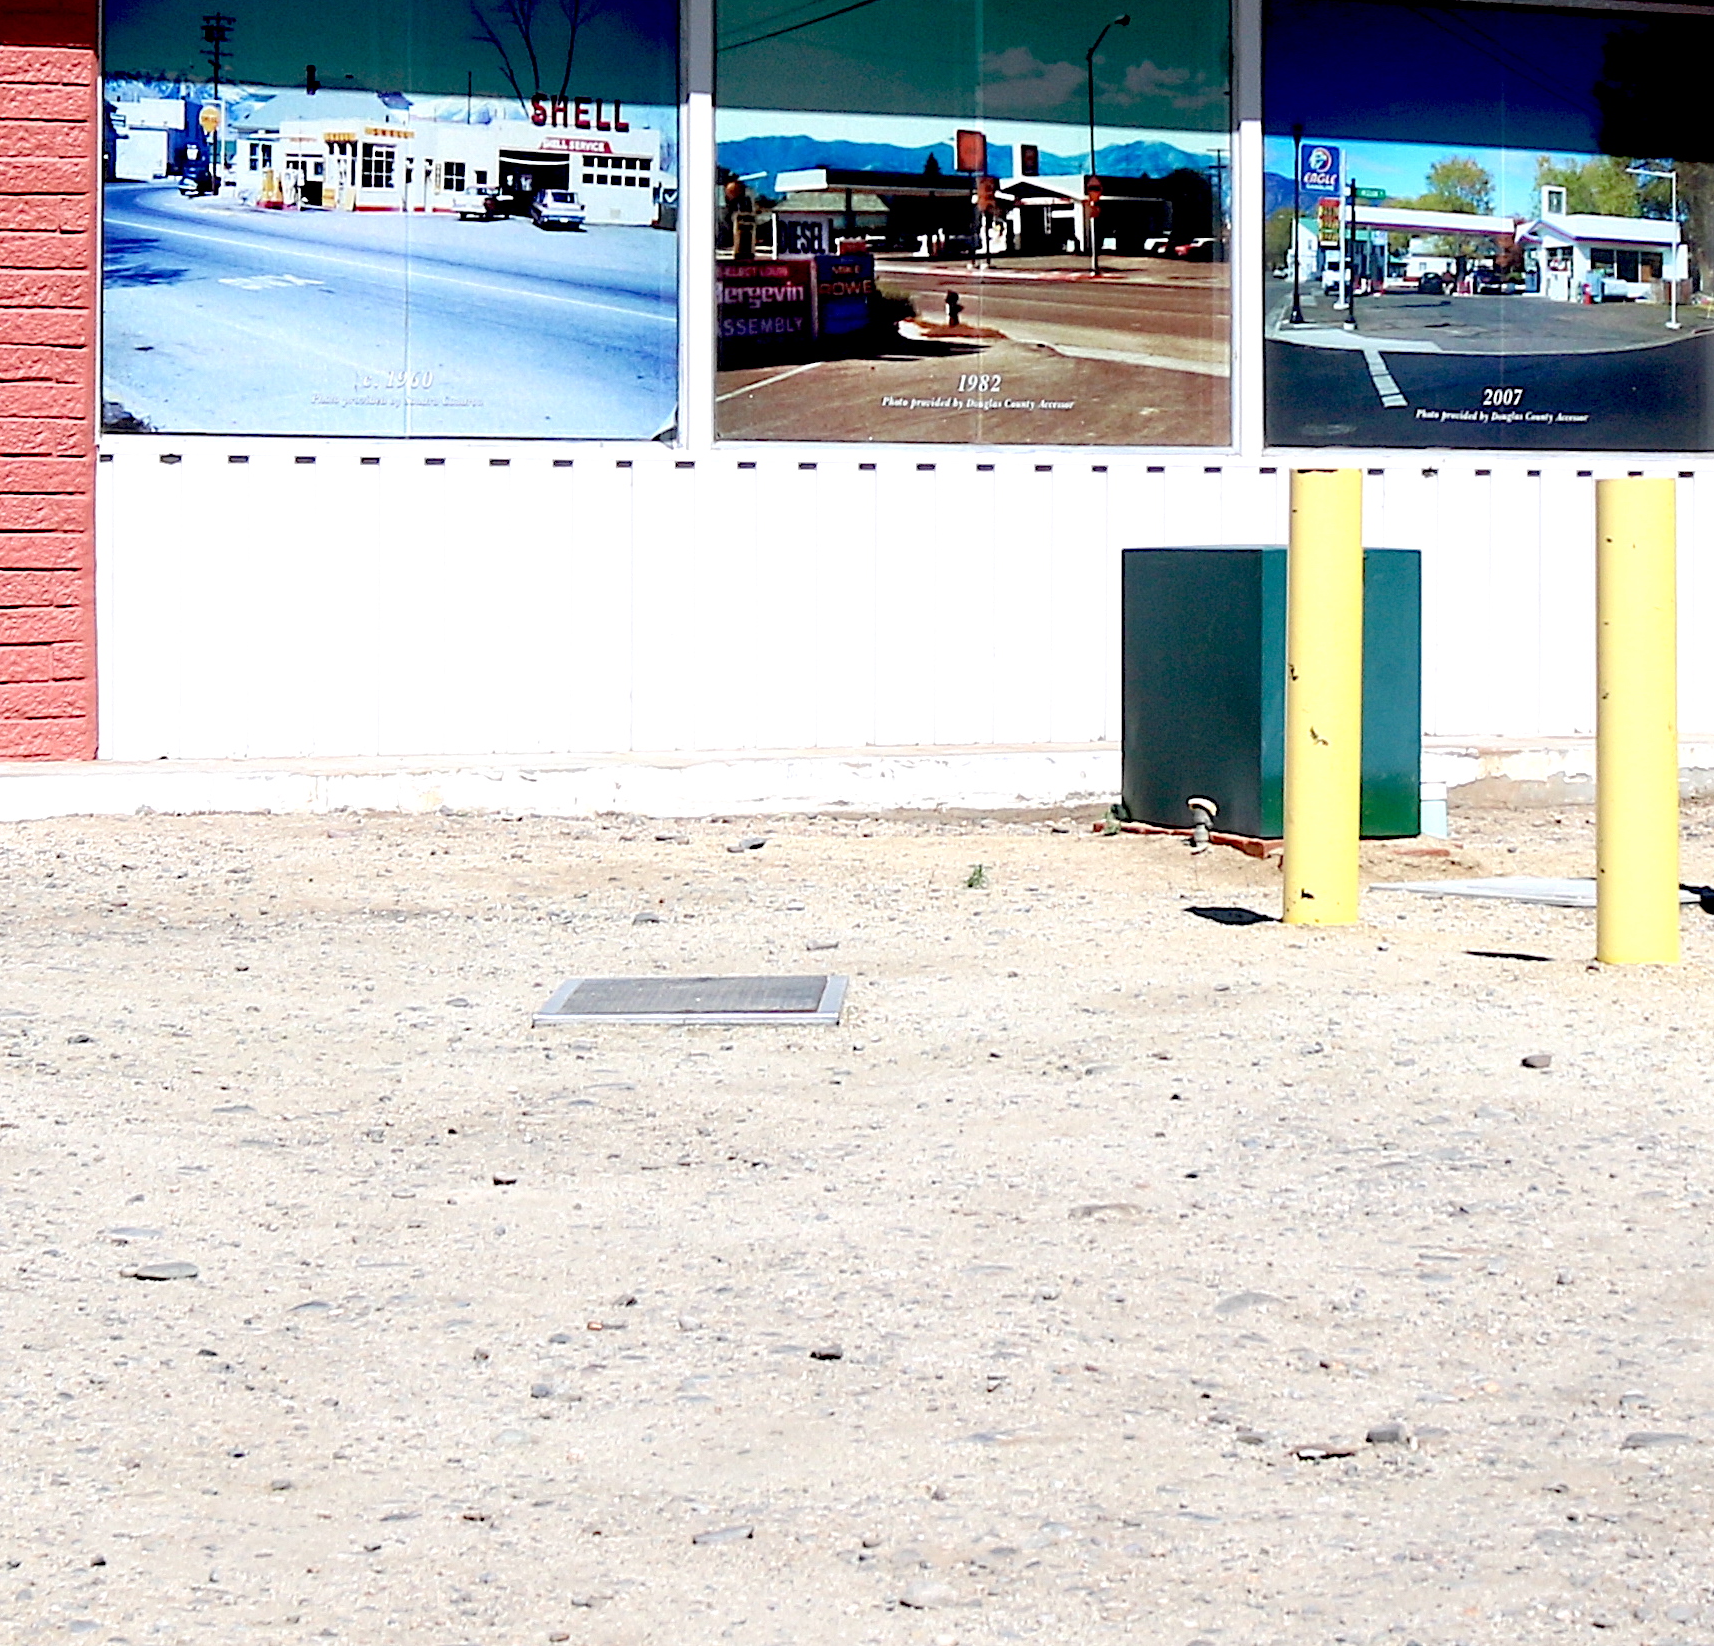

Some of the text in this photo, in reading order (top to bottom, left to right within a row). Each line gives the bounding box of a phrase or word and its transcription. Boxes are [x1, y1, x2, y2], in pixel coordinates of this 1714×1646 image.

[530, 92, 630, 133] SHELL
[568, 140, 605, 152] SERVICE
[1303, 171, 1338, 185] EAGLE
[778, 220, 826, 254] DIESEL
[819, 279, 873, 296] ROWE
[719, 316, 804, 337] SSEMBLY
[385, 370, 435, 390] 1960
[957, 374, 1002, 393] 1982
[881, 395, 908, 407] Photo
[910, 396, 952, 410] provided
[952, 397, 963, 410] by
[966, 398, 1002, 411] Douglas
[1004, 398, 1035, 411] County
[1483, 388, 1523, 406] 2007
[1415, 408, 1440, 419] Photo
[1440, 409, 1478, 423] provided
[1479, 410, 1489, 423] by
[1490, 411, 1524, 423] Douglas
[1525, 411, 1554, 424] County
